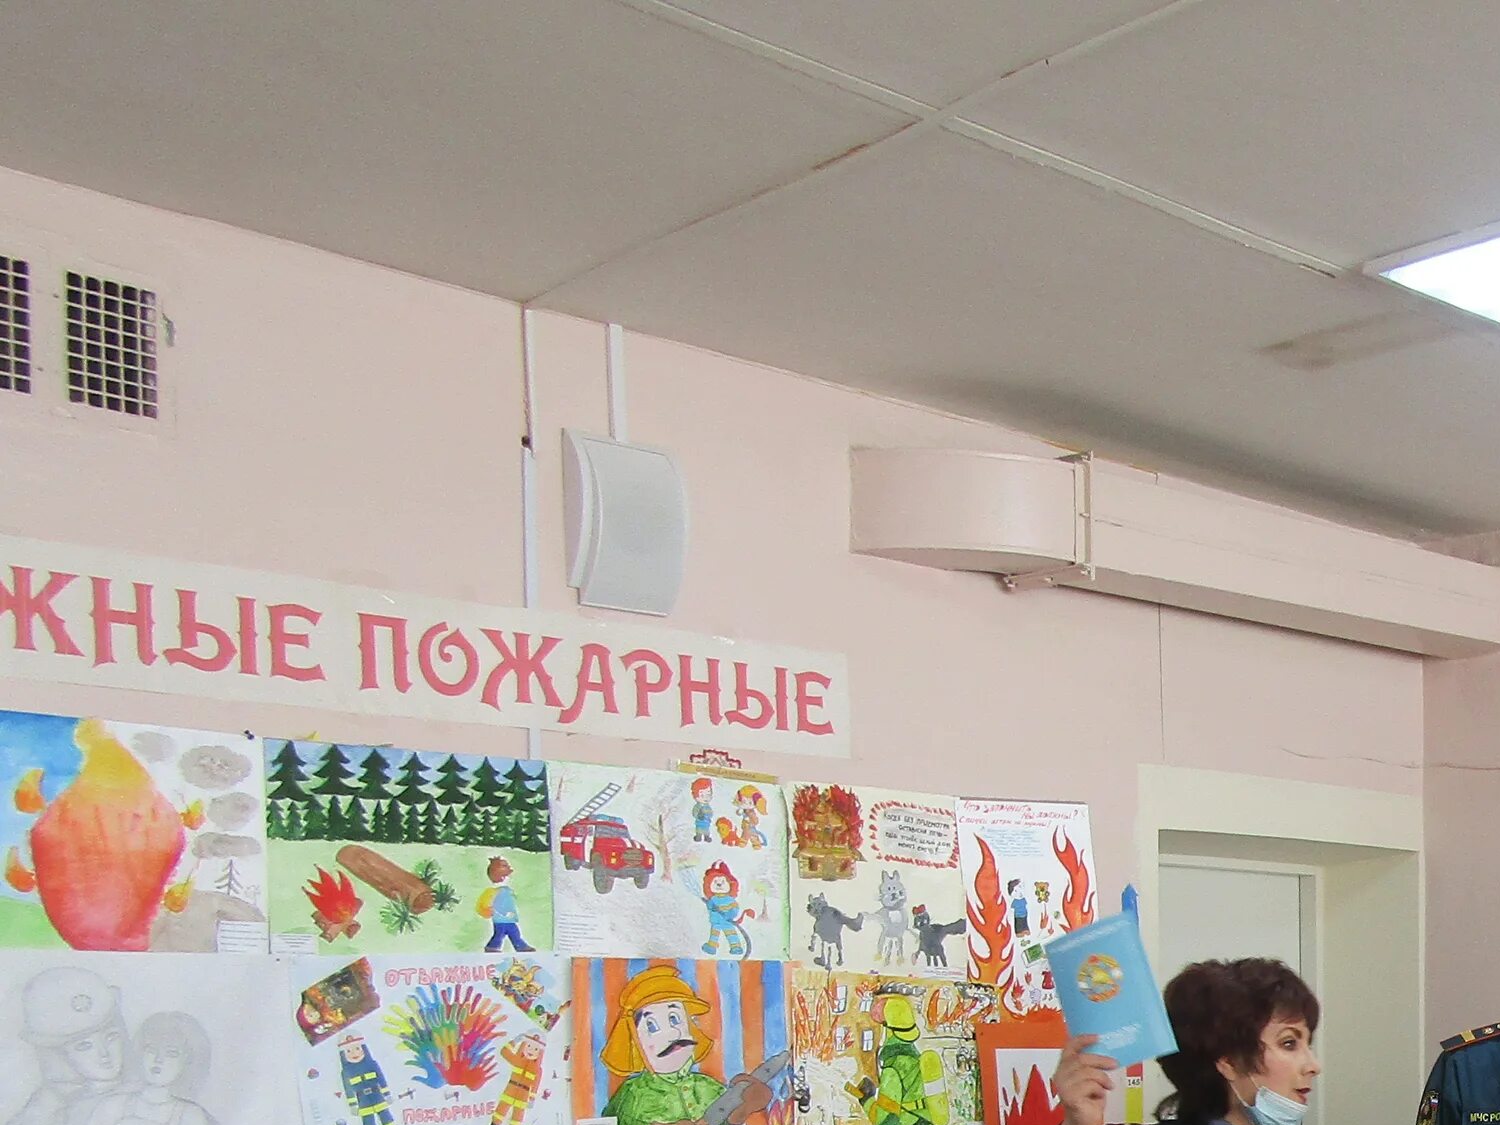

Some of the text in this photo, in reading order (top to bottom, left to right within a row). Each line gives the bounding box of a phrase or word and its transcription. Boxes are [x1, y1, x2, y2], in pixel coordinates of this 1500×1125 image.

[0, 565, 836, 737] ЖНЫЕ ПОЖАРНЫЕ
[402, 1101, 498, 1125] ПОЖАРНЫЕ
[1470, 1111, 1490, 1123] МЧС
